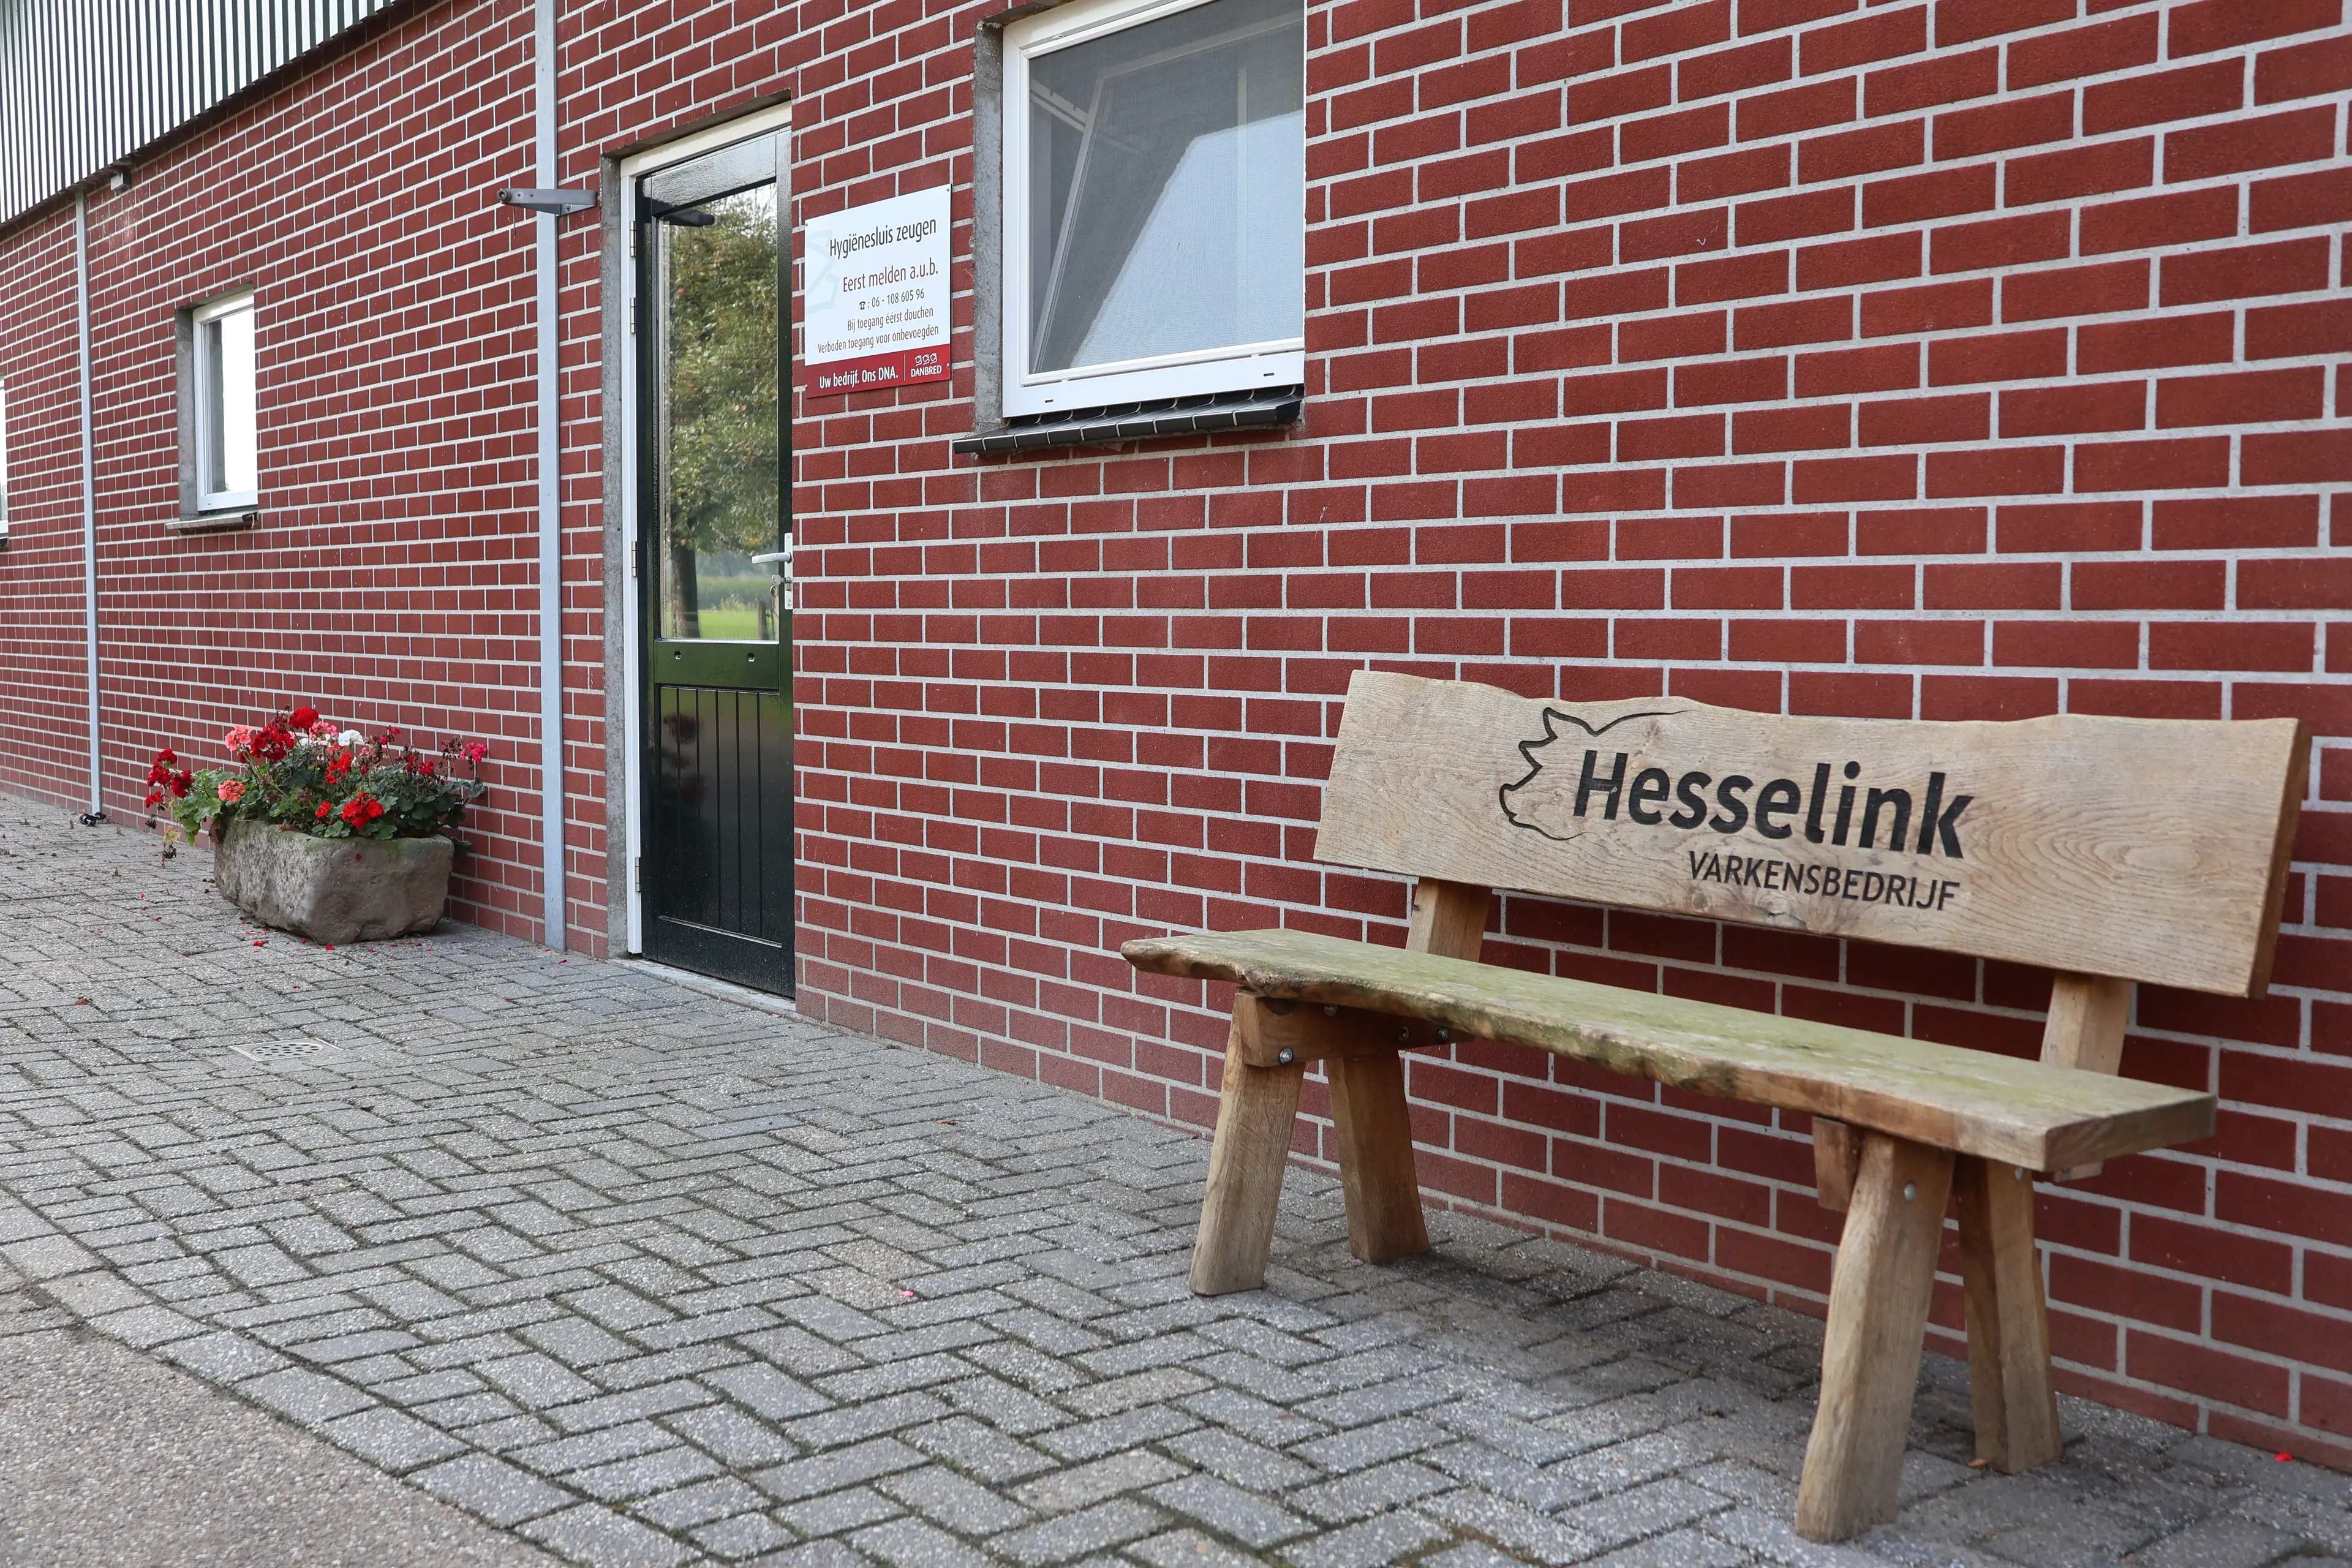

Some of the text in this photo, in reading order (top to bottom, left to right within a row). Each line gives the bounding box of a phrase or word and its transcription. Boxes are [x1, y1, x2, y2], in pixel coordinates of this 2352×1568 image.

[830, 219, 936, 260] Hygiënesluis zeugen
[843, 257, 938, 292] Eerst melden a.u.b.
[872, 296, 880, 307] 06
[902, 291, 913, 303] 605
[916, 288, 924, 299] 96
[858, 315, 883, 330] toegang
[886, 312, 902, 323] éérst
[904, 306, 933, 320] douchen
[818, 324, 938, 353] Verboden toegang voor onbevoegden
[820, 366, 898, 389] Uw bedrijf. Ons DNA.
[911, 364, 941, 377] DANBRED
[1573, 748, 1974, 859] Hesselink
[1689, 850, 1961, 911] VARKENSBEDRIJF
